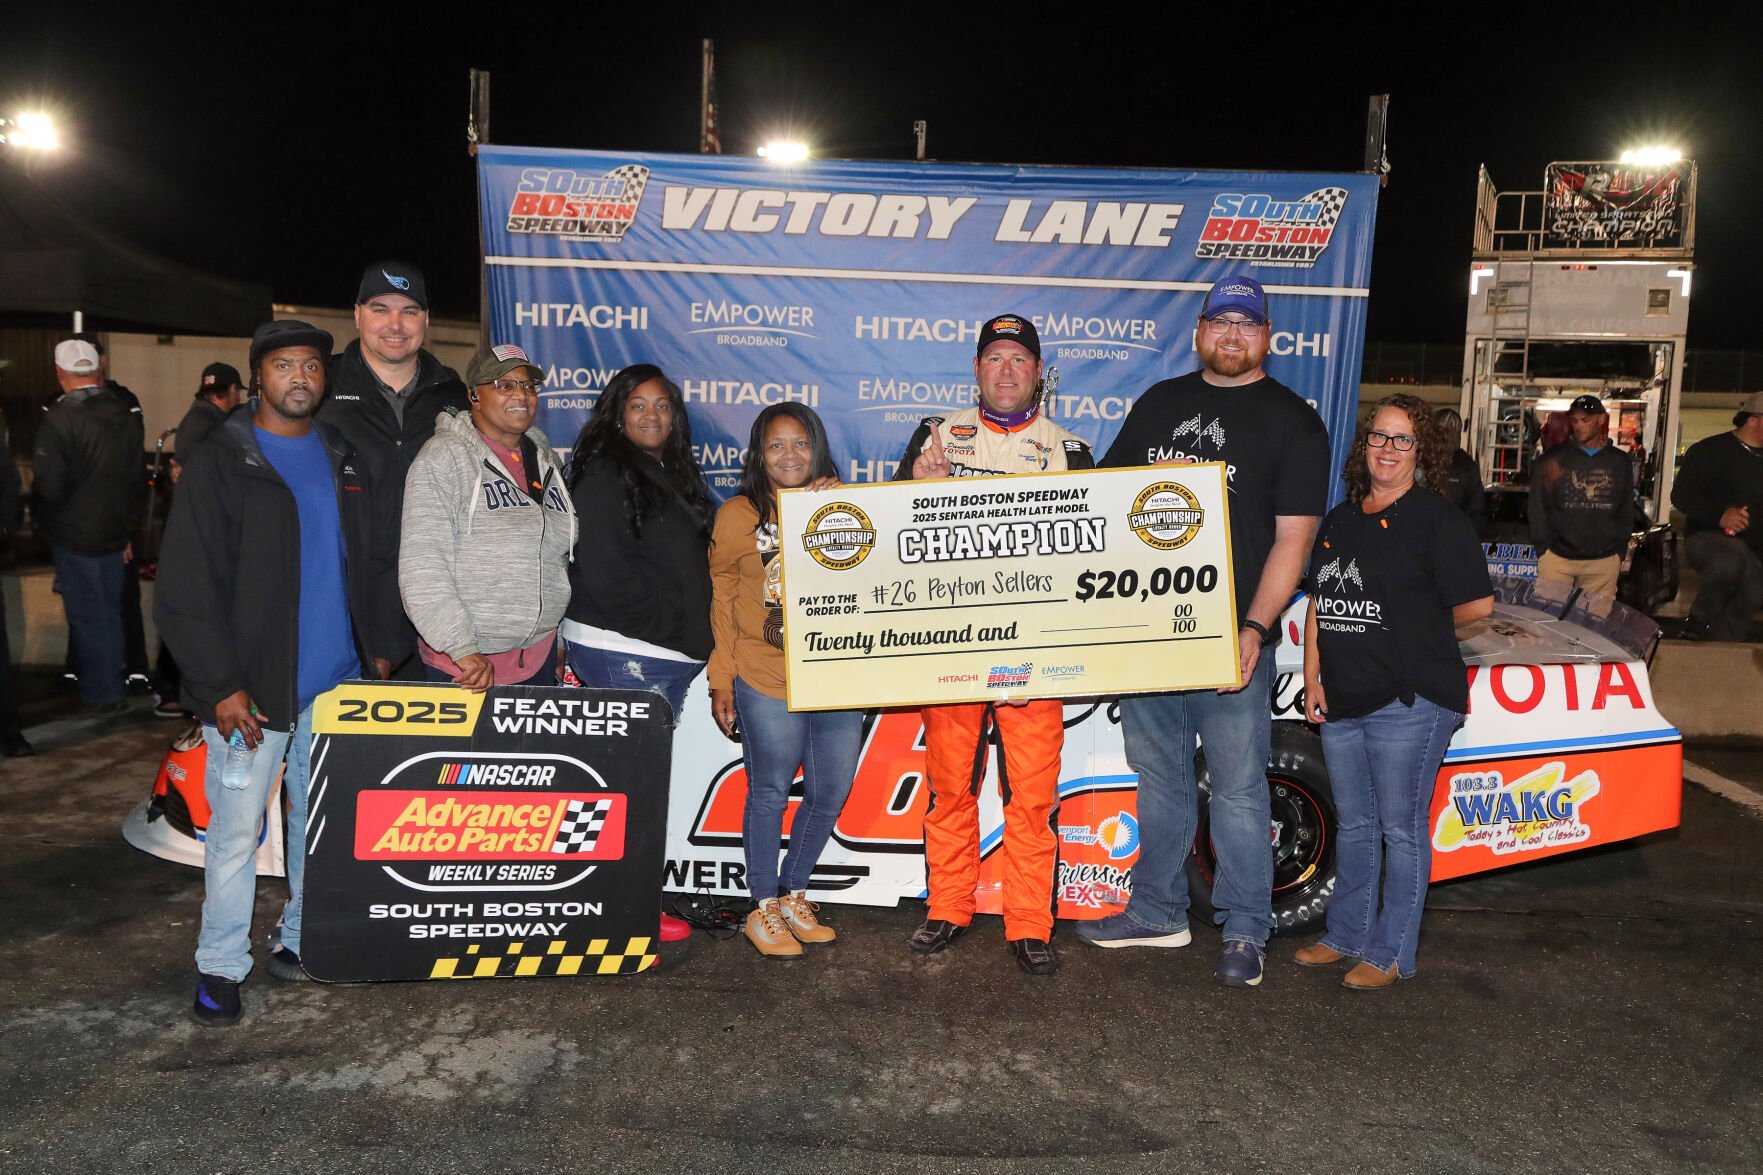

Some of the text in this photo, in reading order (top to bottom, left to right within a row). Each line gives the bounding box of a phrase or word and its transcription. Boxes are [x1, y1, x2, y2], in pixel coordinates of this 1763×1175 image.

[519, 169, 626, 197] SOUTH
[511, 193, 636, 220] BOSTON
[1209, 193, 1323, 221] SOUTH
[508, 217, 632, 235] SPEEDWAY
[662, 186, 1184, 247] VICTORY LANE
[1552, 220, 1674, 232] CHAMPION
[1200, 218, 1331, 244] BOSTON
[1197, 242, 1324, 260] SPEEDWAY
[1220, 284, 1254, 295] EMPOWER
[515, 303, 648, 330] HITACHI
[691, 299, 814, 327] EMPOWER
[855, 315, 981, 343] HITACH
[1032, 312, 1157, 340] EMPOWER
[717, 335, 787, 347] BROADBAND
[1057, 348, 1129, 360] BROADBAND
[543, 364, 620, 388] MPOW
[683, 380, 819, 408] HITACHI
[858, 377, 981, 404] EMPOWER
[547, 399, 596, 409] BROADB
[884, 412, 928, 423] BROAD
[912, 488, 1089, 510] SOUTH BOSTON SPEEDWAY
[1139, 484, 1193, 503] SOUTH BOSTON
[813, 505, 866, 524] SOUTH BOSTON
[912, 503, 1090, 523] 2025 SENTARA HEALTH LATE MODEL
[1131, 511, 1200, 528] CHAMPIONSHIP
[805, 531, 873, 548] CHAMPIONSHIP
[898, 517, 1106, 564] CHAMPION
[1146, 536, 1188, 547] SPEEDWAY
[820, 556, 860, 567] SPEEDWAY
[1507, 564, 1539, 576] SUPPL
[871, 570, 1053, 606] #26 Peyton Sellers
[1075, 564, 1218, 603] $20,000
[799, 594, 857, 606] PAY TO THE
[1314, 594, 1383, 620] MPOWER
[806, 605, 860, 616] ORDER OF:
[1174, 604, 1193, 617] 00
[1172, 619, 1197, 633] 100
[1320, 621, 1366, 633] BROADBAND
[804, 621, 1019, 655] Twenty thousand and
[938, 674, 979, 684] HITACHI
[988, 674, 1029, 682] BOSTON
[989, 666, 1026, 675] SOUTH
[1042, 665, 1085, 675] EMPOWER
[338, 700, 468, 724] 2025
[493, 697, 650, 719] FEATURE
[492, 717, 629, 736] WINNER
[466, 764, 556, 786] NASCAR
[1454, 776, 1499, 793] 103.3
[393, 797, 552, 827] Advance
[1453, 787, 1574, 827] WAKG
[370, 827, 544, 852] Auto Parts
[1065, 833, 1097, 843] Energy
[1496, 838, 1516, 850] and
[1547, 826, 1586, 841] Classics
[428, 865, 557, 881] WEEKLY SERIES
[369, 902, 603, 919] SOUTH BOSTON
[409, 922, 568, 938] SPEEDWAY
